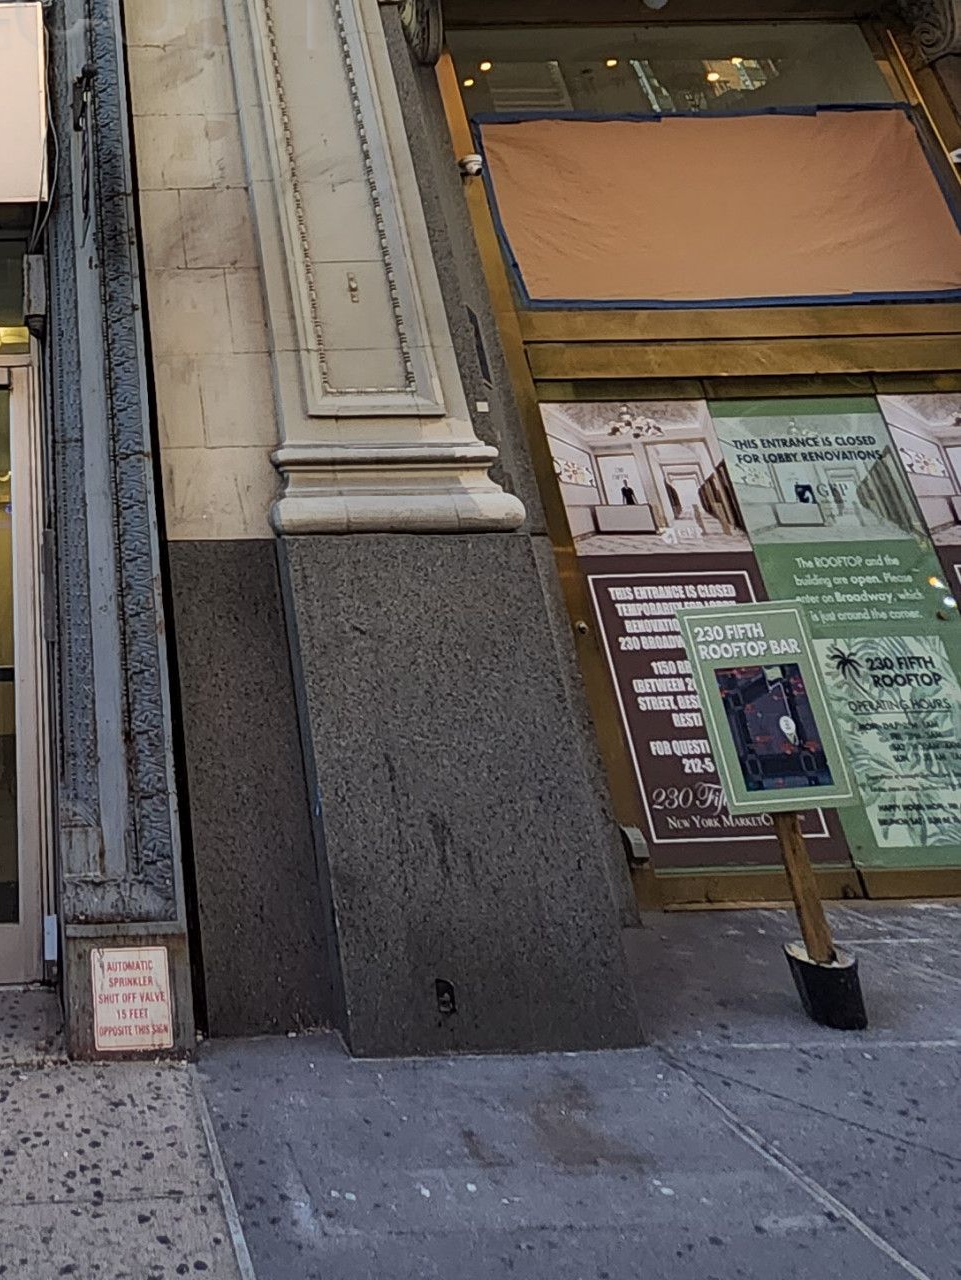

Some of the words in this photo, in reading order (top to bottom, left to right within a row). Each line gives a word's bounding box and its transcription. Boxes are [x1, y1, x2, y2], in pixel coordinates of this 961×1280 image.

[732, 439, 758, 450] THIS
[761, 436, 821, 448] ENTRANCE
[821, 437, 832, 447] IS
[835, 435, 876, 447] CLOSED
[736, 453, 760, 464] FOR
[762, 452, 798, 464] LOBBY
[801, 449, 883, 463] RENOVATIONS
[795, 557, 814, 569] The
[814, 556, 863, 568] ROOFTOP
[865, 555, 883, 567] and
[885, 554, 900, 566] the
[850, 575, 883, 587] open.
[608, 587, 633, 601] THIS
[633, 586, 685, 601] ENTRANCE
[687, 585, 697, 598] IS
[697, 584, 737, 598] CLOSED
[834, 590, 897, 604] Broadway,
[871, 607, 888, 620] the
[624, 619, 681, 633] RENOVATIO
[693, 625, 724, 642] 230
[724, 622, 765, 640] FIFTH
[618, 637, 641, 651] 230
[640, 635, 685, 650] BROADW
[698, 640, 768, 660] ROOFTOP
[768, 638, 802, 655] BAR
[651, 661, 677, 675] 1150
[676, 660, 692, 674] BR
[865, 656, 894, 671] 230
[897, 655, 937, 670] FIFTH
[685, 677, 697, 691] 2
[871, 673, 943, 688] ROOFTOP
[677, 695, 702, 709] BES
[847, 699, 910, 713] OPERATING
[910, 697, 952, 710] HOURS
[649, 740, 672, 756] FOR
[672, 739, 711, 756] QUESTI
[682, 757, 715, 773] 212-5
[652, 787, 693, 809] 230
[106, 959, 154, 972] AUTOMATIC
[108, 975, 154, 988] SPRINKLER
[98, 993, 119, 1005] SHUT
[122, 992, 138, 1003] OFF
[140, 991, 166, 1004] VALVE
[117, 1010, 127, 1020] 15
[129, 1008, 149, 1019] FEET
[98, 1025, 133, 1038] OPPOSITE
[134, 1024, 150, 1036] THIS
[151, 1023, 169, 1036] SIGN
